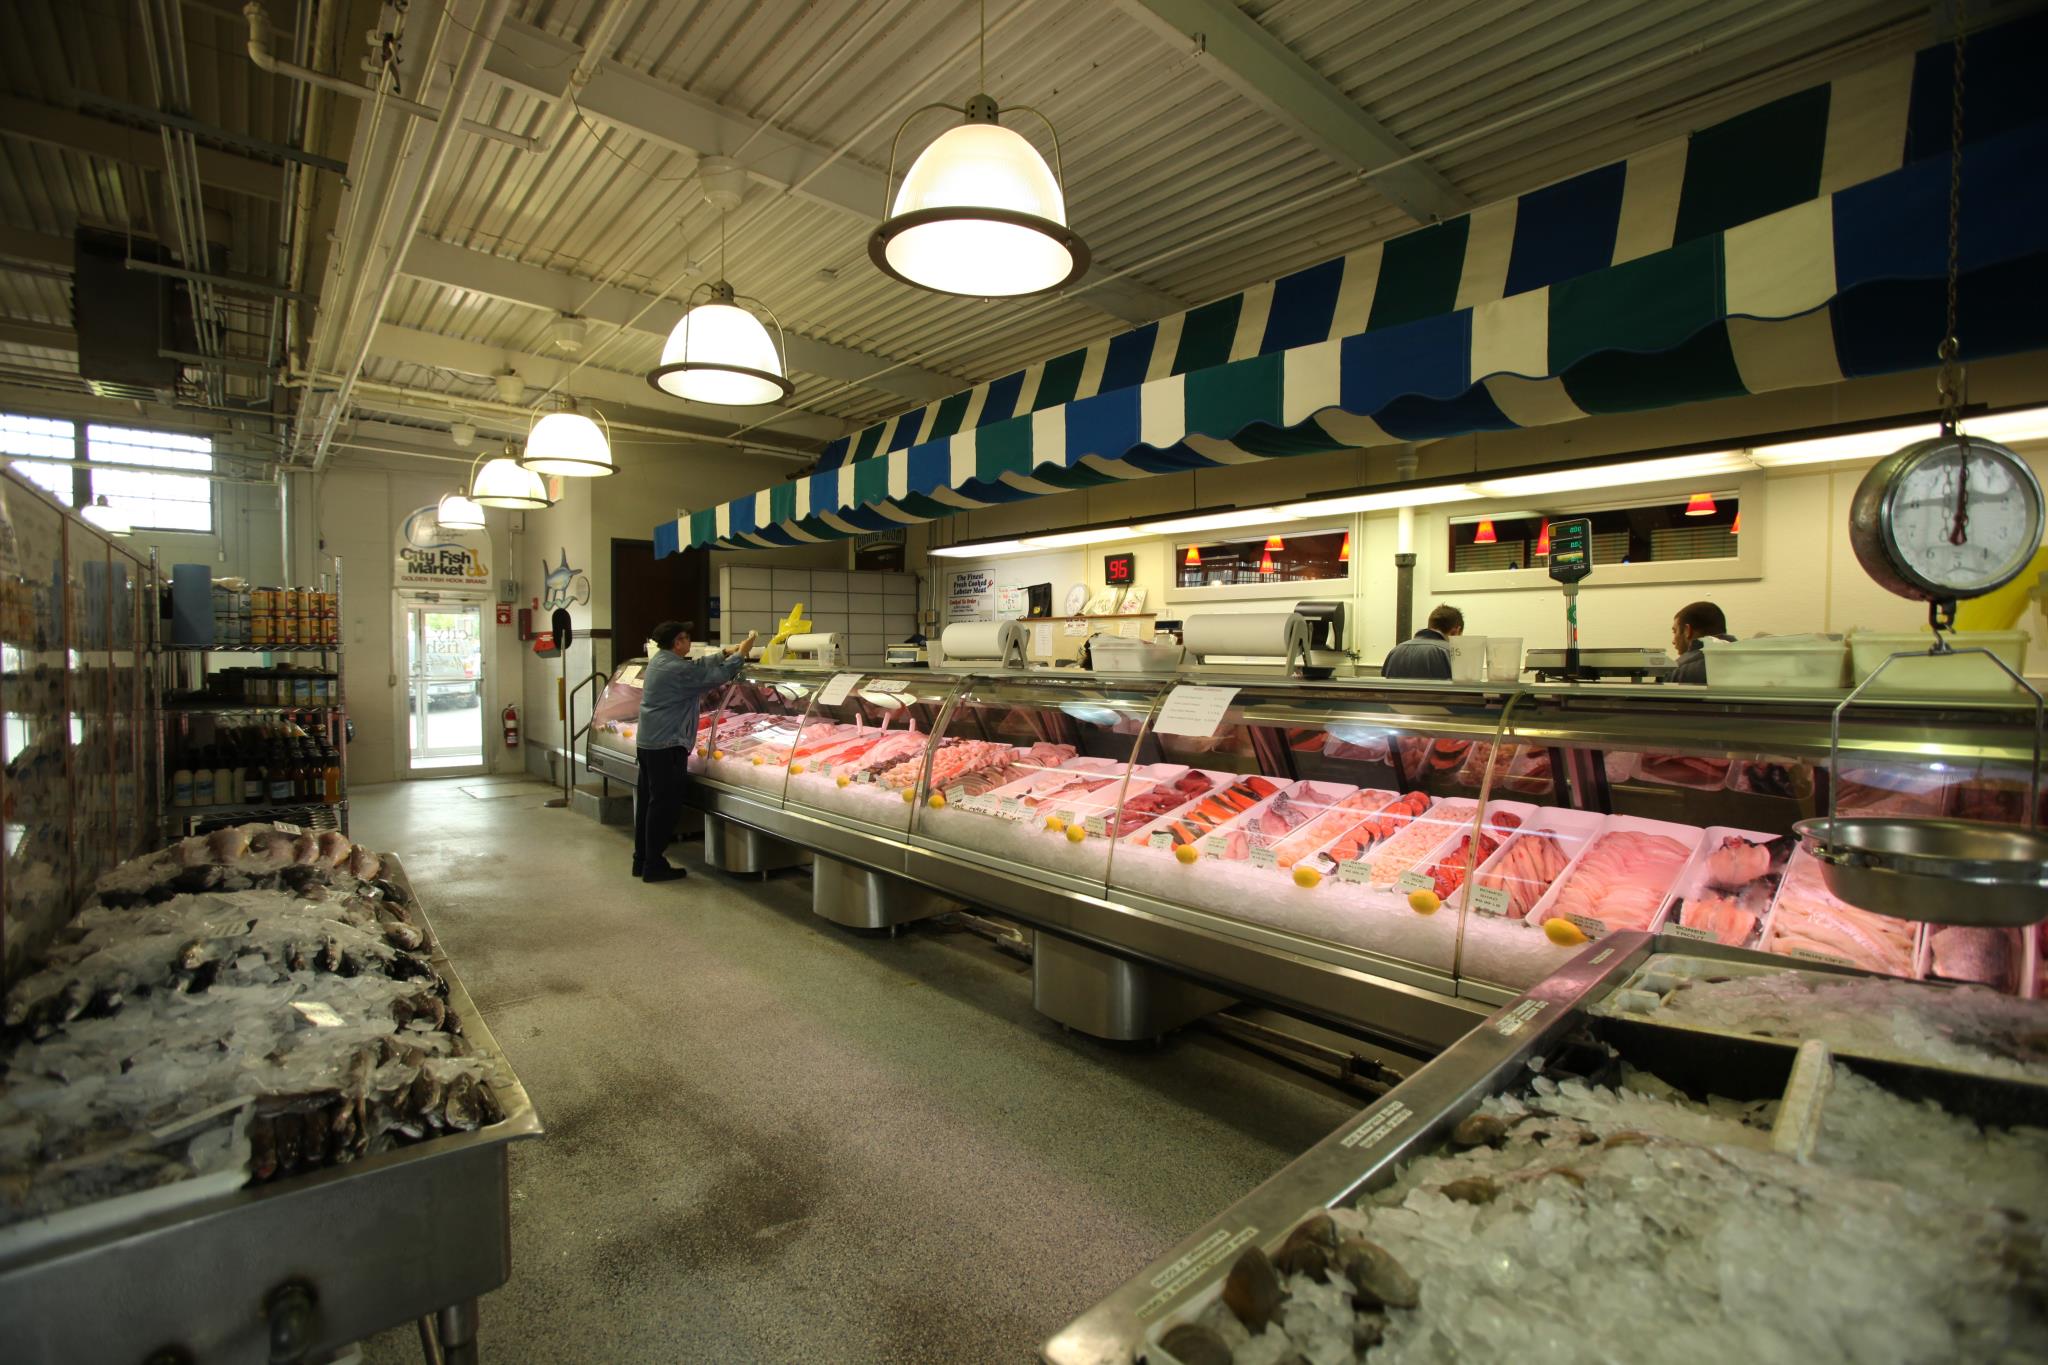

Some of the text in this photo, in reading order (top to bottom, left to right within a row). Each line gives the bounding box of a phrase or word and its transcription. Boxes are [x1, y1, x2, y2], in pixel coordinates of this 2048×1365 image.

[401, 548, 471, 564] City Fish
[1926, 548, 1935, 560] 6
[1981, 548, 1989, 561] 4
[408, 563, 464, 576] Market
[957, 573, 984, 582] The Finest
[968, 579, 987, 588] Cooked
[1676, 926, 1707, 935] BONED
[1676, 931, 1704, 940] TROUT
